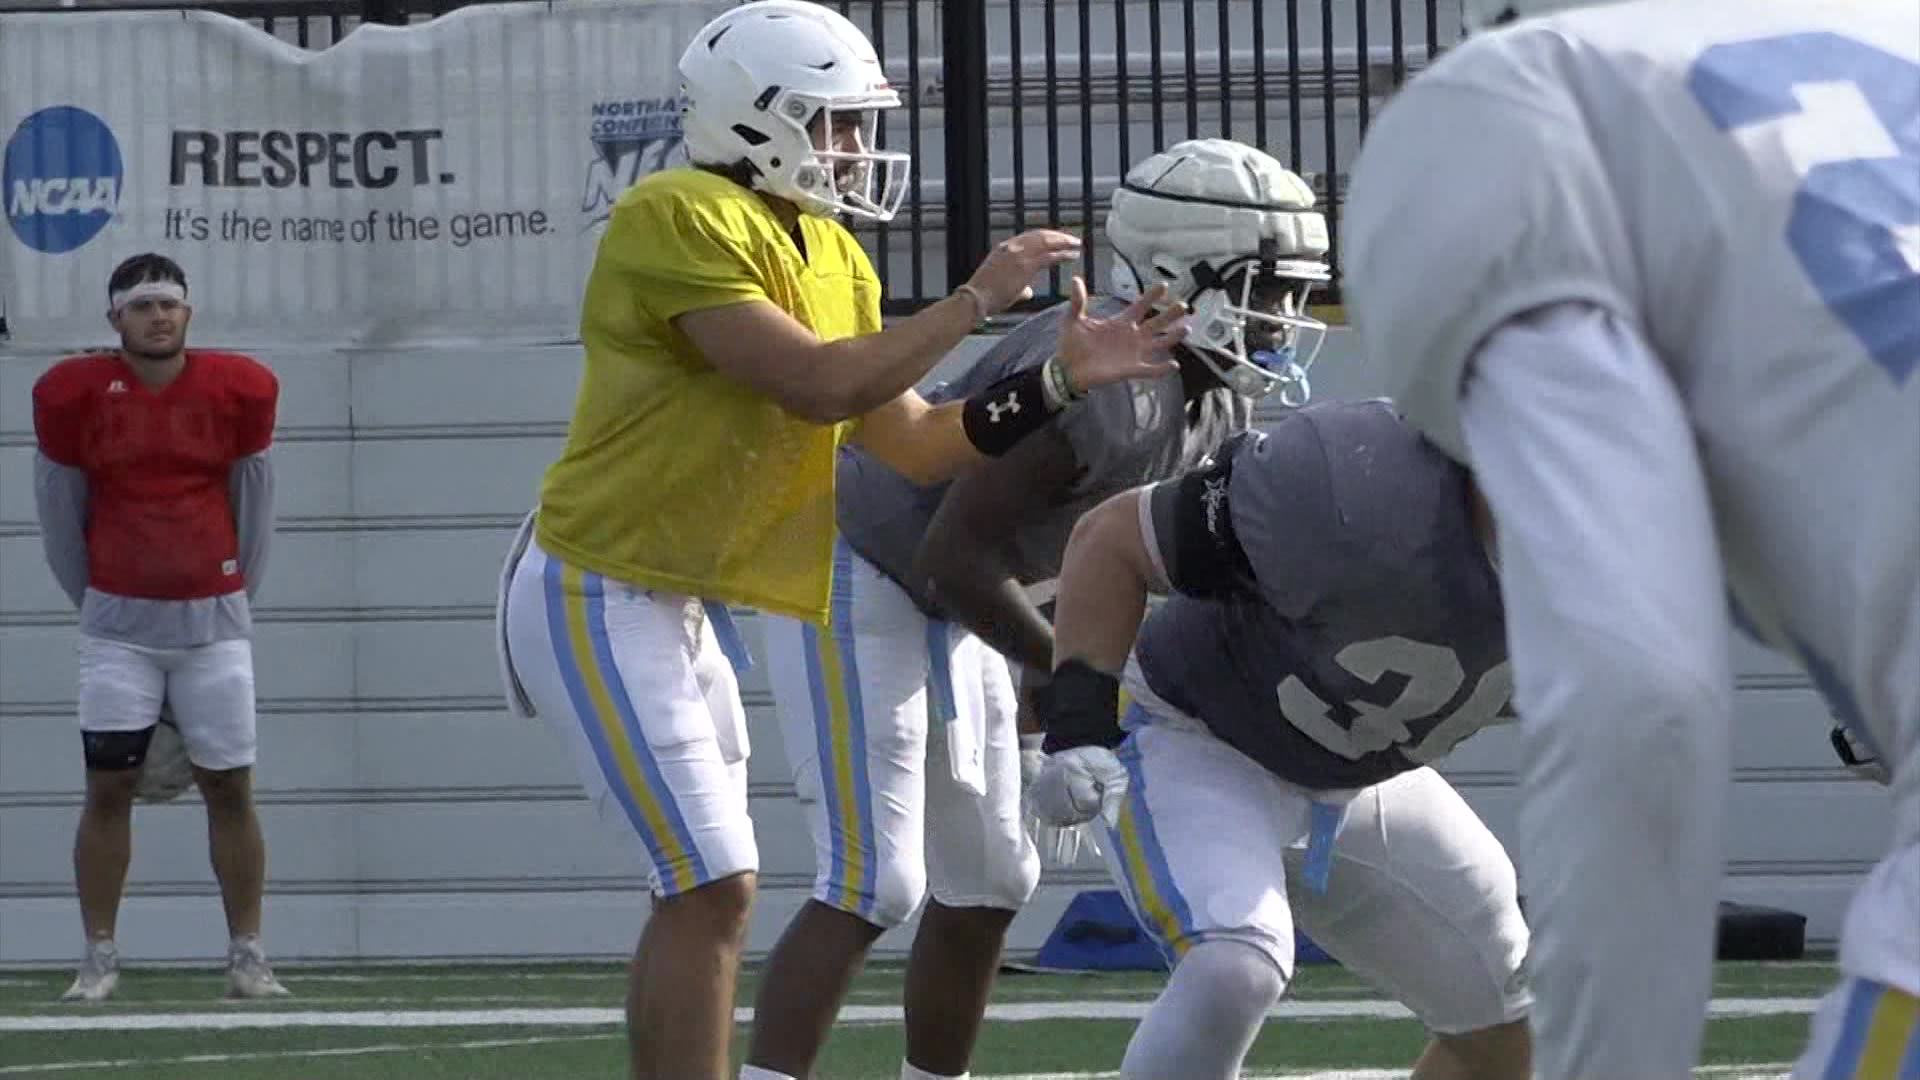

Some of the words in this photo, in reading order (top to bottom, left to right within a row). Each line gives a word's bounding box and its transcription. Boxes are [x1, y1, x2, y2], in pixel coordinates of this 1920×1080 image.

[169, 129, 455, 188] RESPECT.
[10, 176, 120, 217] NCAA
[165, 208, 210, 241] It's
[221, 210, 272, 241] the
[281, 217, 345, 242] name
[351, 210, 377, 243] of
[388, 211, 440, 240] the
[450, 209, 556, 247] game.
